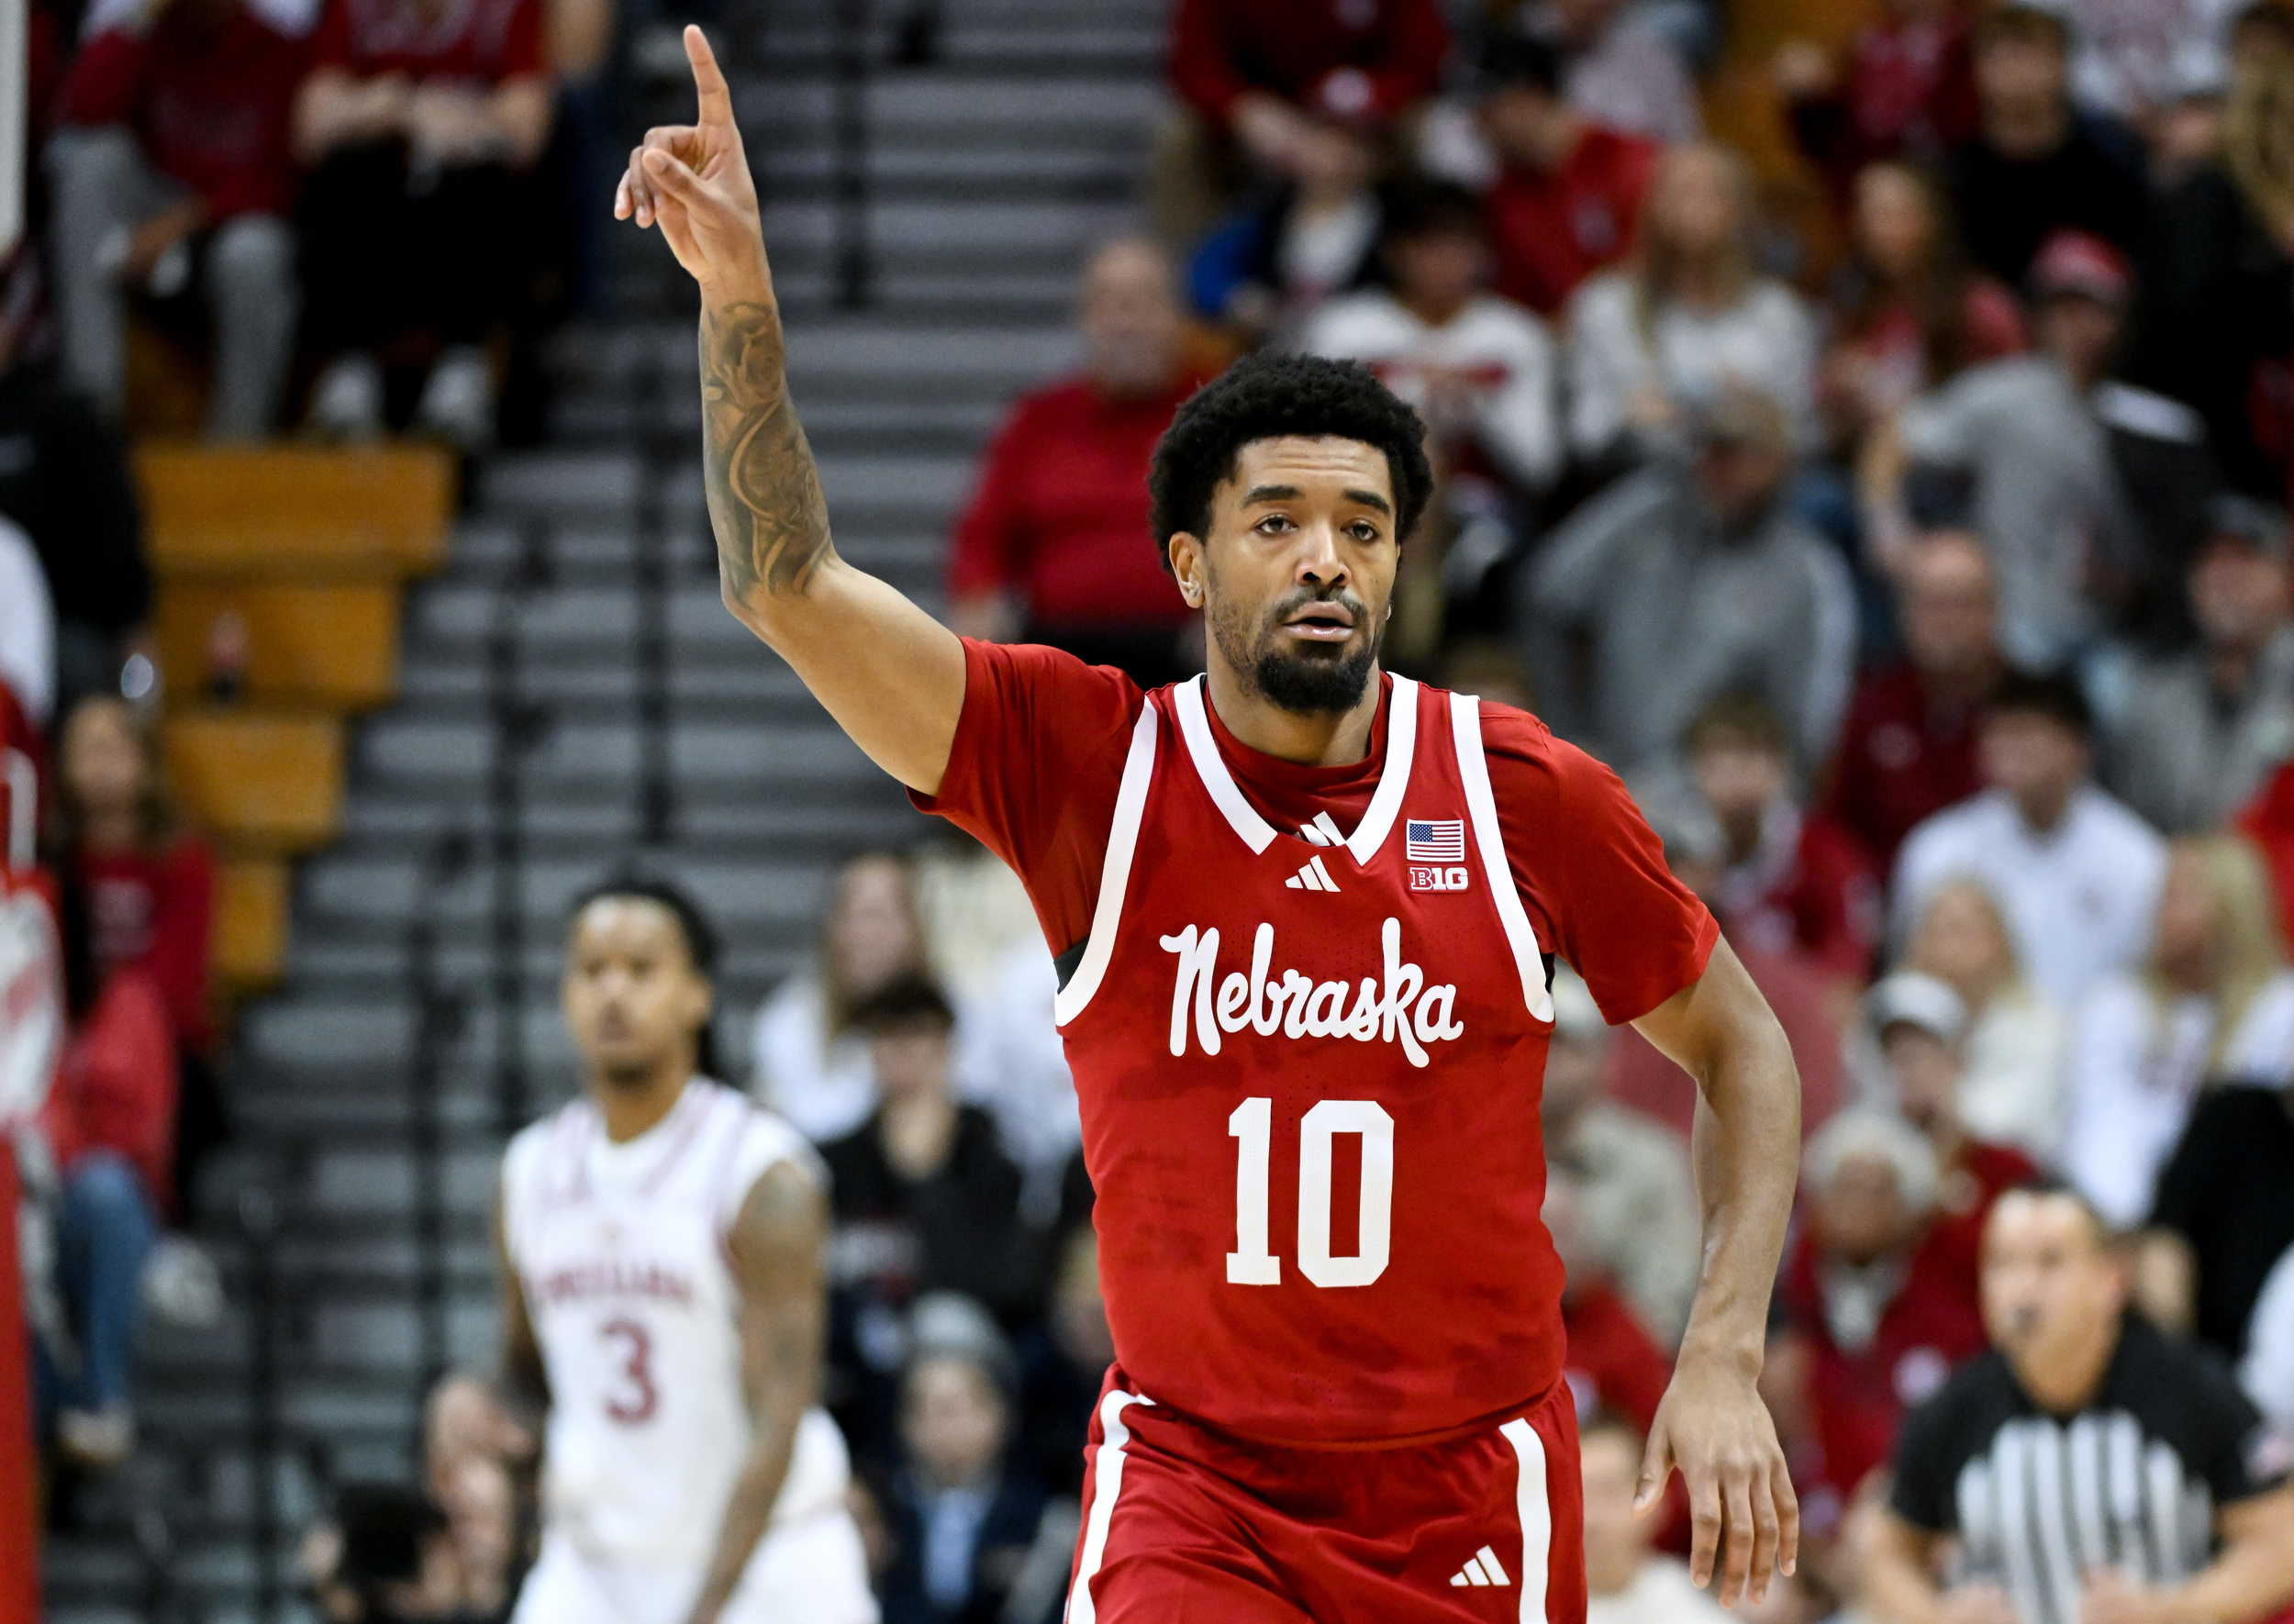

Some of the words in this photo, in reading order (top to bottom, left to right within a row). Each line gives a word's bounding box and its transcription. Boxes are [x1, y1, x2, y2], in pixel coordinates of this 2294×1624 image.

[1159, 918, 1464, 1067] Nebraska
[1226, 1097, 1395, 1287] 10
[602, 1318, 659, 1426] 3
